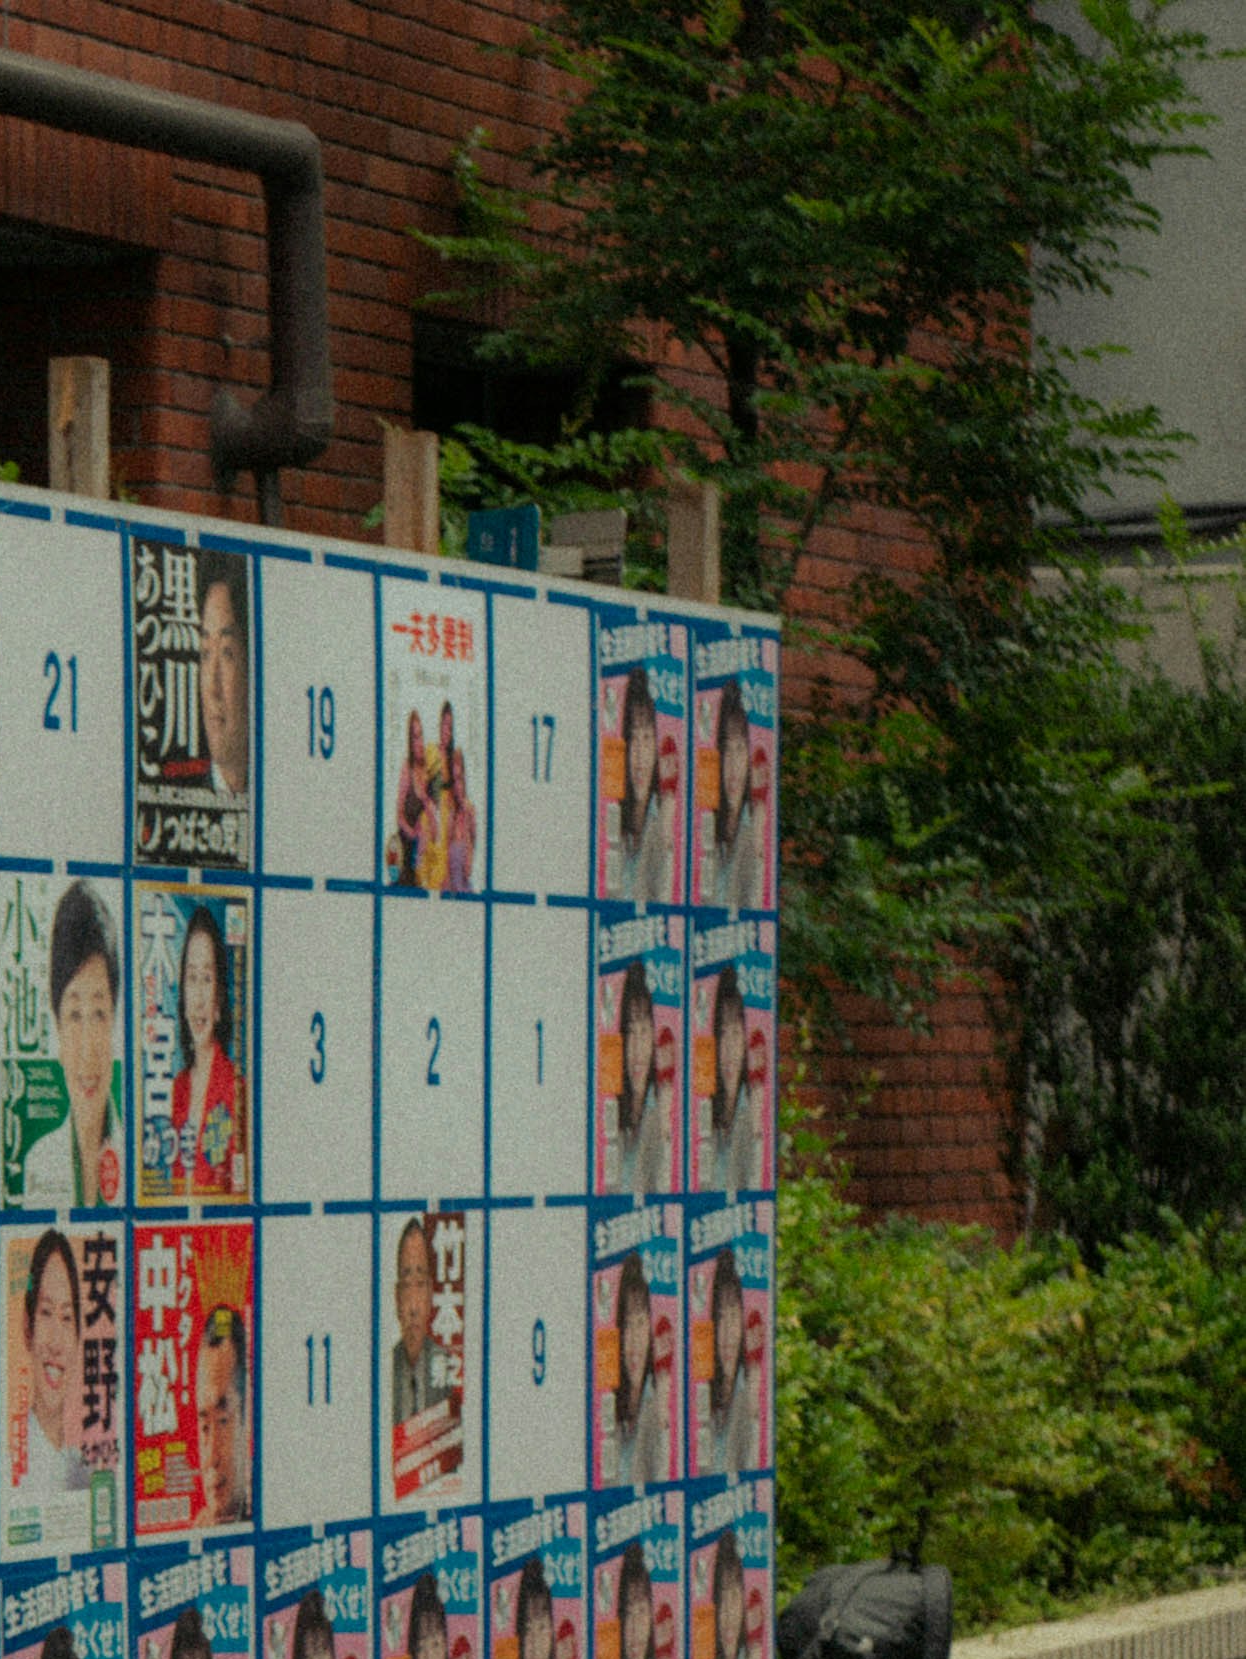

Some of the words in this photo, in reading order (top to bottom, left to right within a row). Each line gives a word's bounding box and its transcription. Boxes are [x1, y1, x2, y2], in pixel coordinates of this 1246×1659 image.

[136, 545, 164, 778] あつひこ
[159, 548, 201, 758] 黒川
[43, 651, 79, 733] 21
[307, 685, 335, 760] 19
[532, 713, 556, 783] 17
[310, 1011, 326, 1085] 3
[426, 1016, 442, 1086] 2
[535, 1017, 544, 1085] 1
[431, 1219, 465, 1345] 竹本
[81, 1231, 120, 1433] 安野
[138, 1233, 179, 1437] 中松
[305, 1333, 331, 1406] 11
[532, 1317, 547, 1387] 9
